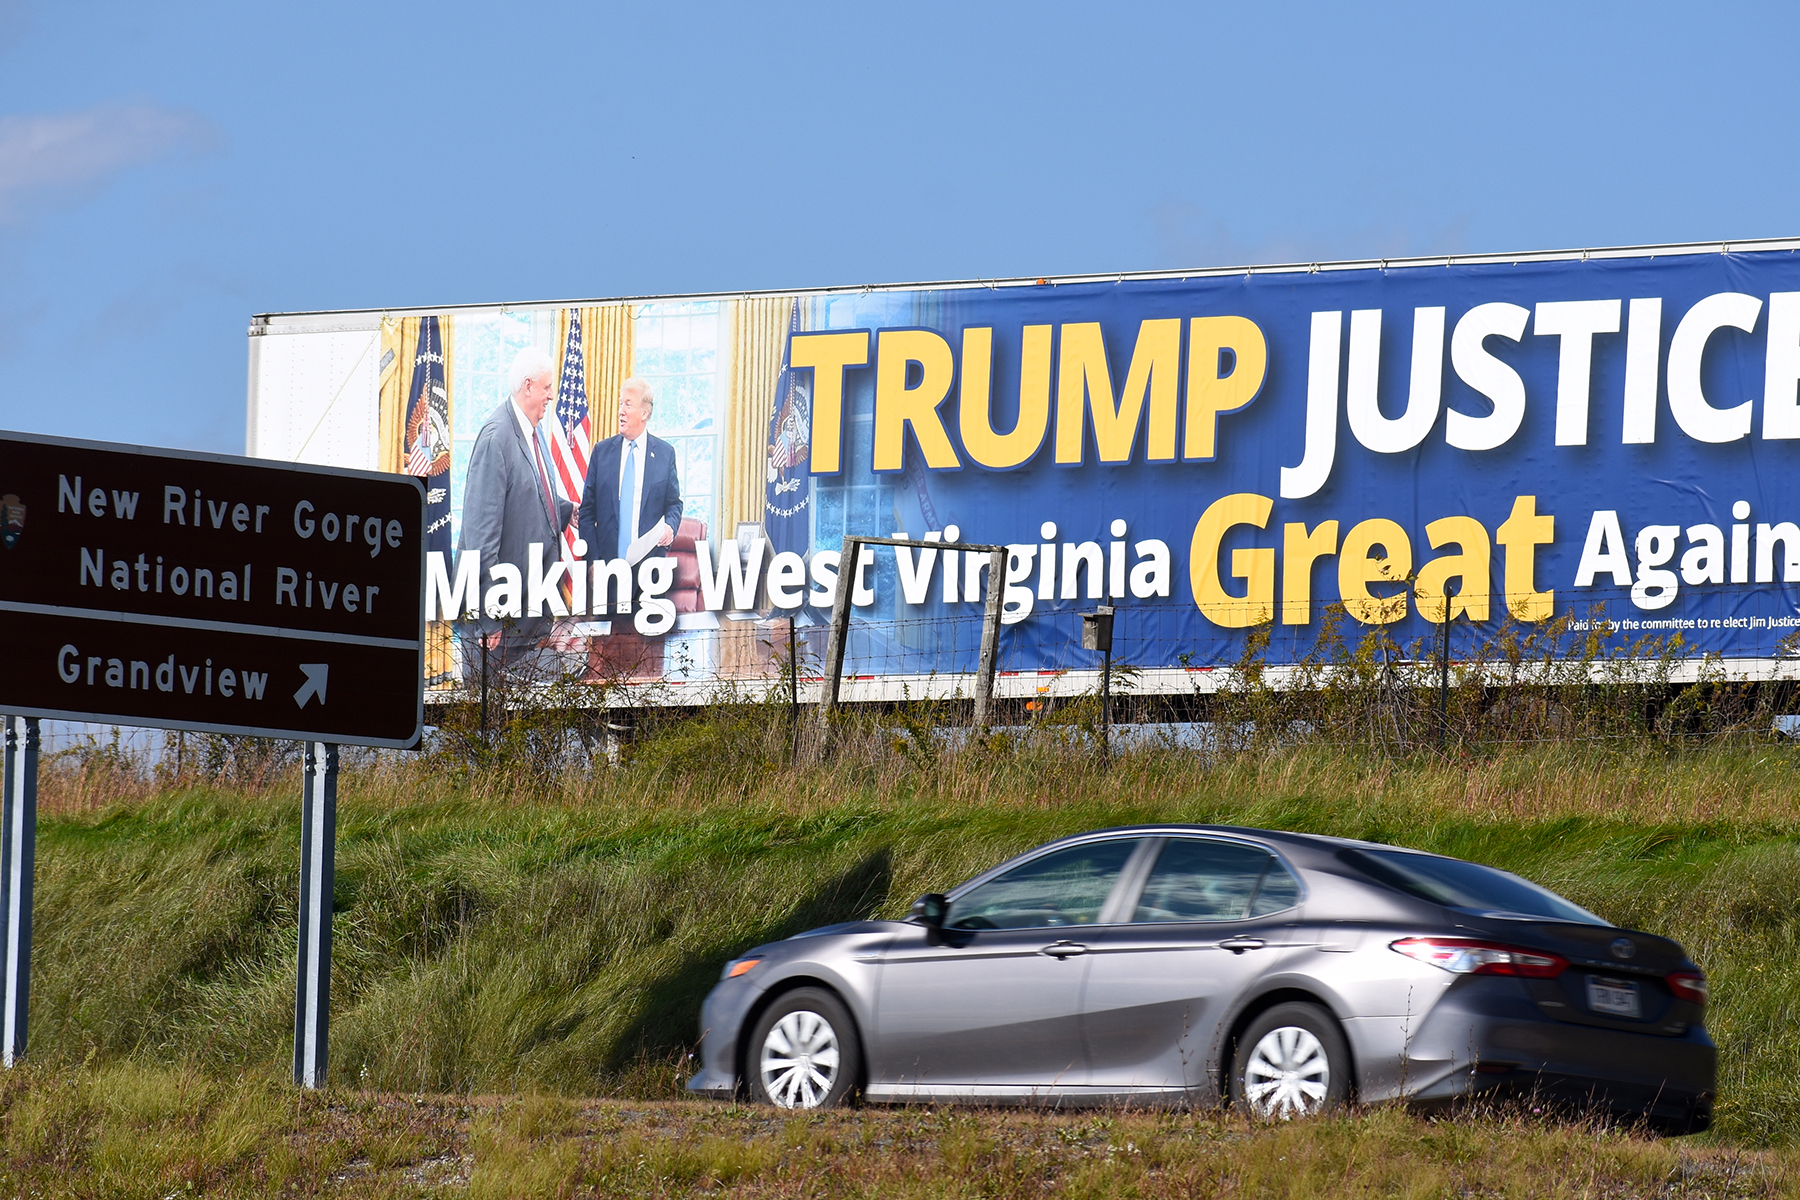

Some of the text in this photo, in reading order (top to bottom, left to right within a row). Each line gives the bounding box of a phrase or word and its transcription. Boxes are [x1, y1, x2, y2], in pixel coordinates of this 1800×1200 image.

[789, 315, 1267, 473] TRUMP
[58, 474, 403, 558] New River Gorge
[80, 547, 380, 614] National River
[425, 493, 1800, 636] Making West Virginia Great Again
[1567, 619, 1589, 631] Paid
[1607, 619, 1620, 633] by
[1622, 618, 1640, 630] the
[1641, 617, 1695, 630] committee
[1697, 618, 1709, 629] to
[1710, 618, 1721, 628] re
[1723, 616, 1748, 628] elect
[1748, 616, 1766, 630] Jim
[1767, 615, 1800, 629] Justice
[58, 644, 268, 700] Grandview
